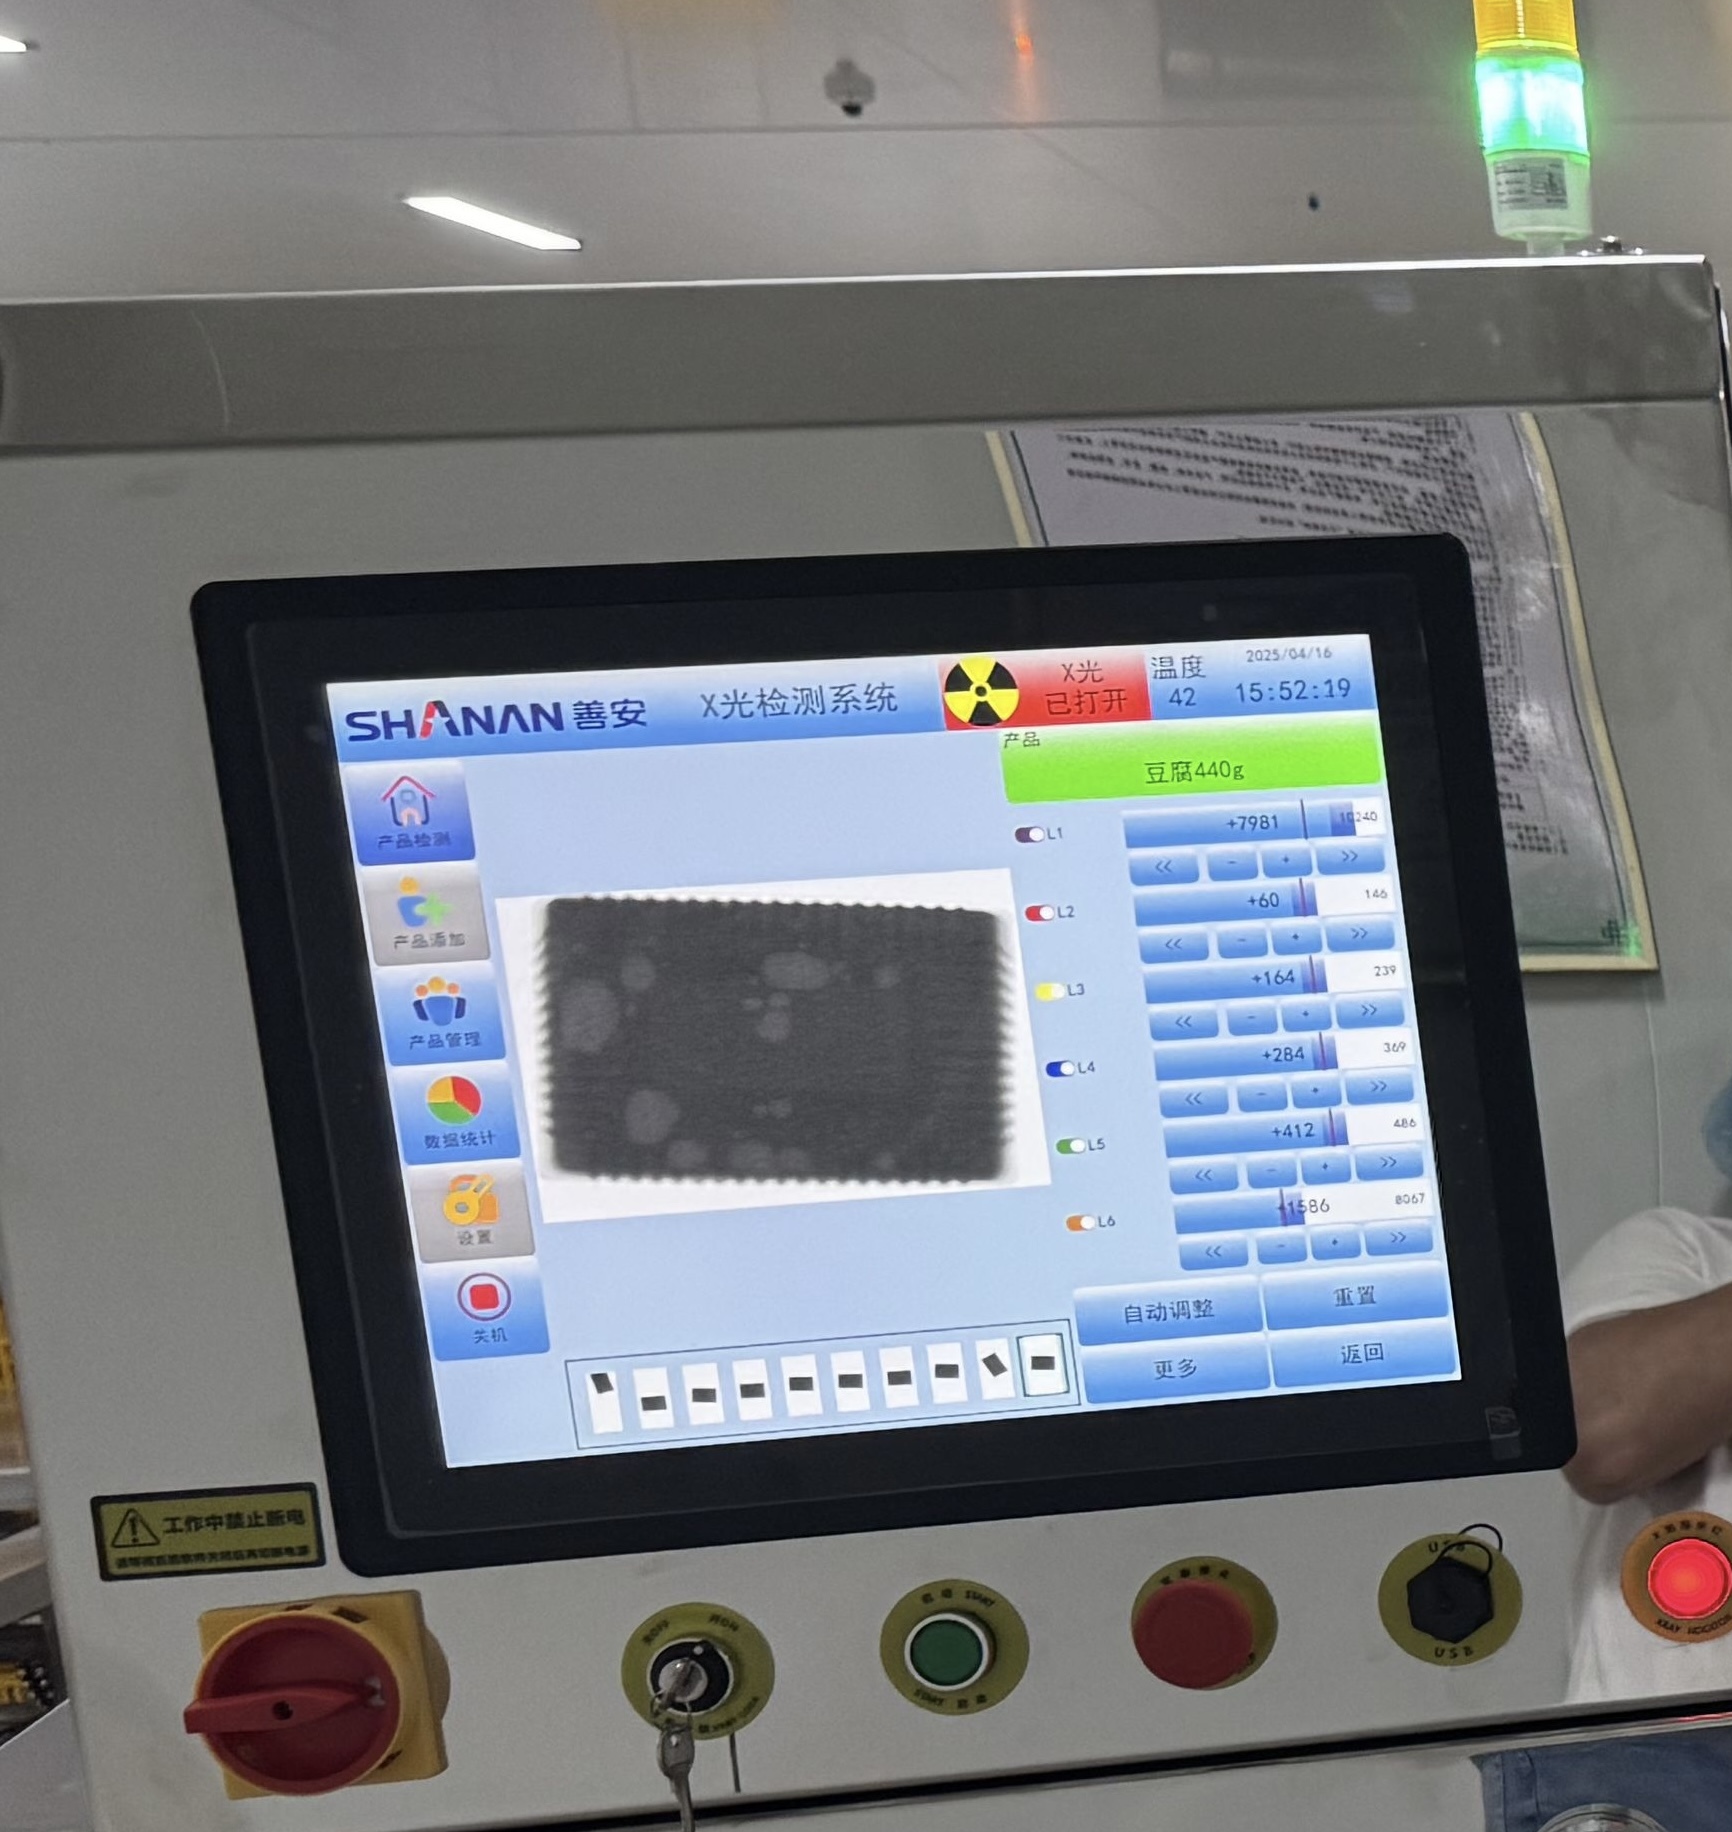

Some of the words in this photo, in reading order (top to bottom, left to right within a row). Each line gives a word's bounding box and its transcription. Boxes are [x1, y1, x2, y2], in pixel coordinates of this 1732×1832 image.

[1246, 646, 1332, 663] 2025/04/16
[1062, 660, 1104, 684] X光
[1152, 656, 1207, 680] 温度
[1169, 688, 1196, 708] 42
[1235, 678, 1351, 704] 15:52:19
[701, 683, 898, 718] X光检测系统
[1045, 688, 1128, 715] 已打开
[346, 700, 564, 742] SHANAN
[573, 699, 647, 731] 善安
[1003, 732, 1041, 748] 产品
[1146, 760, 1245, 784] 豆腐440g
[1227, 815, 1278, 831] +7981
[1047, 828, 1063, 840] L1
[1247, 892, 1280, 909] +60
[1057, 906, 1075, 919] L2
[1252, 970, 1295, 986] +164
[1067, 984, 1085, 996] L3
[409, 1032, 481, 1050] 产品管理
[1263, 1046, 1304, 1062] +284
[1077, 1061, 1095, 1074] L4
[1271, 1123, 1314, 1138] +412
[1088, 1138, 1105, 1151] L5
[1098, 1215, 1115, 1228] L6
[1333, 1285, 1376, 1307] 重置
[1124, 1299, 1215, 1324] 自动调整
[1341, 1343, 1385, 1365] 返回
[1154, 1357, 1198, 1380] 更多
[1434, 1645, 1474, 1659] USB
